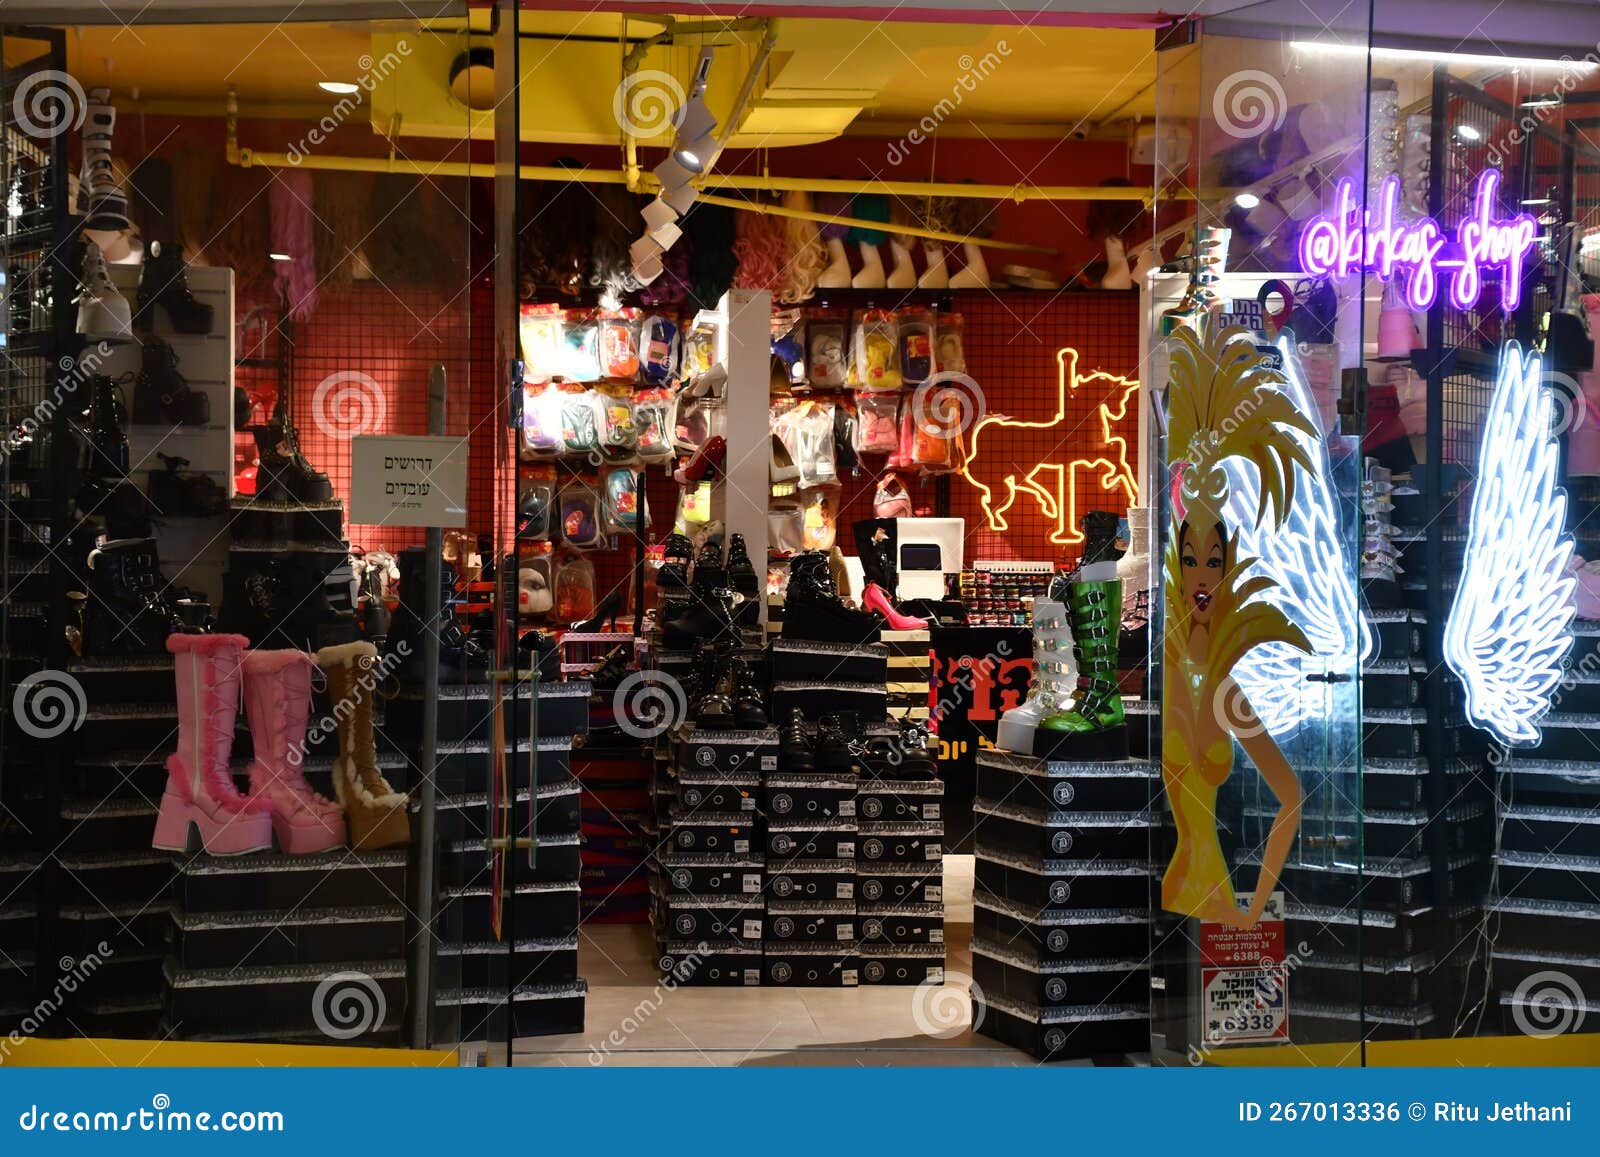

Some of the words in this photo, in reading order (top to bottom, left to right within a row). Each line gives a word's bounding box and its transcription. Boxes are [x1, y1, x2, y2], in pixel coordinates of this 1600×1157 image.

[1304, 173, 1536, 307] @kirkas_shop
[384, 456, 433, 471] דרושים
[385, 481, 431, 496] עובדים
[1222, 978, 1255, 989] מוקד
[1210, 989, 1255, 1002] מודיעין
